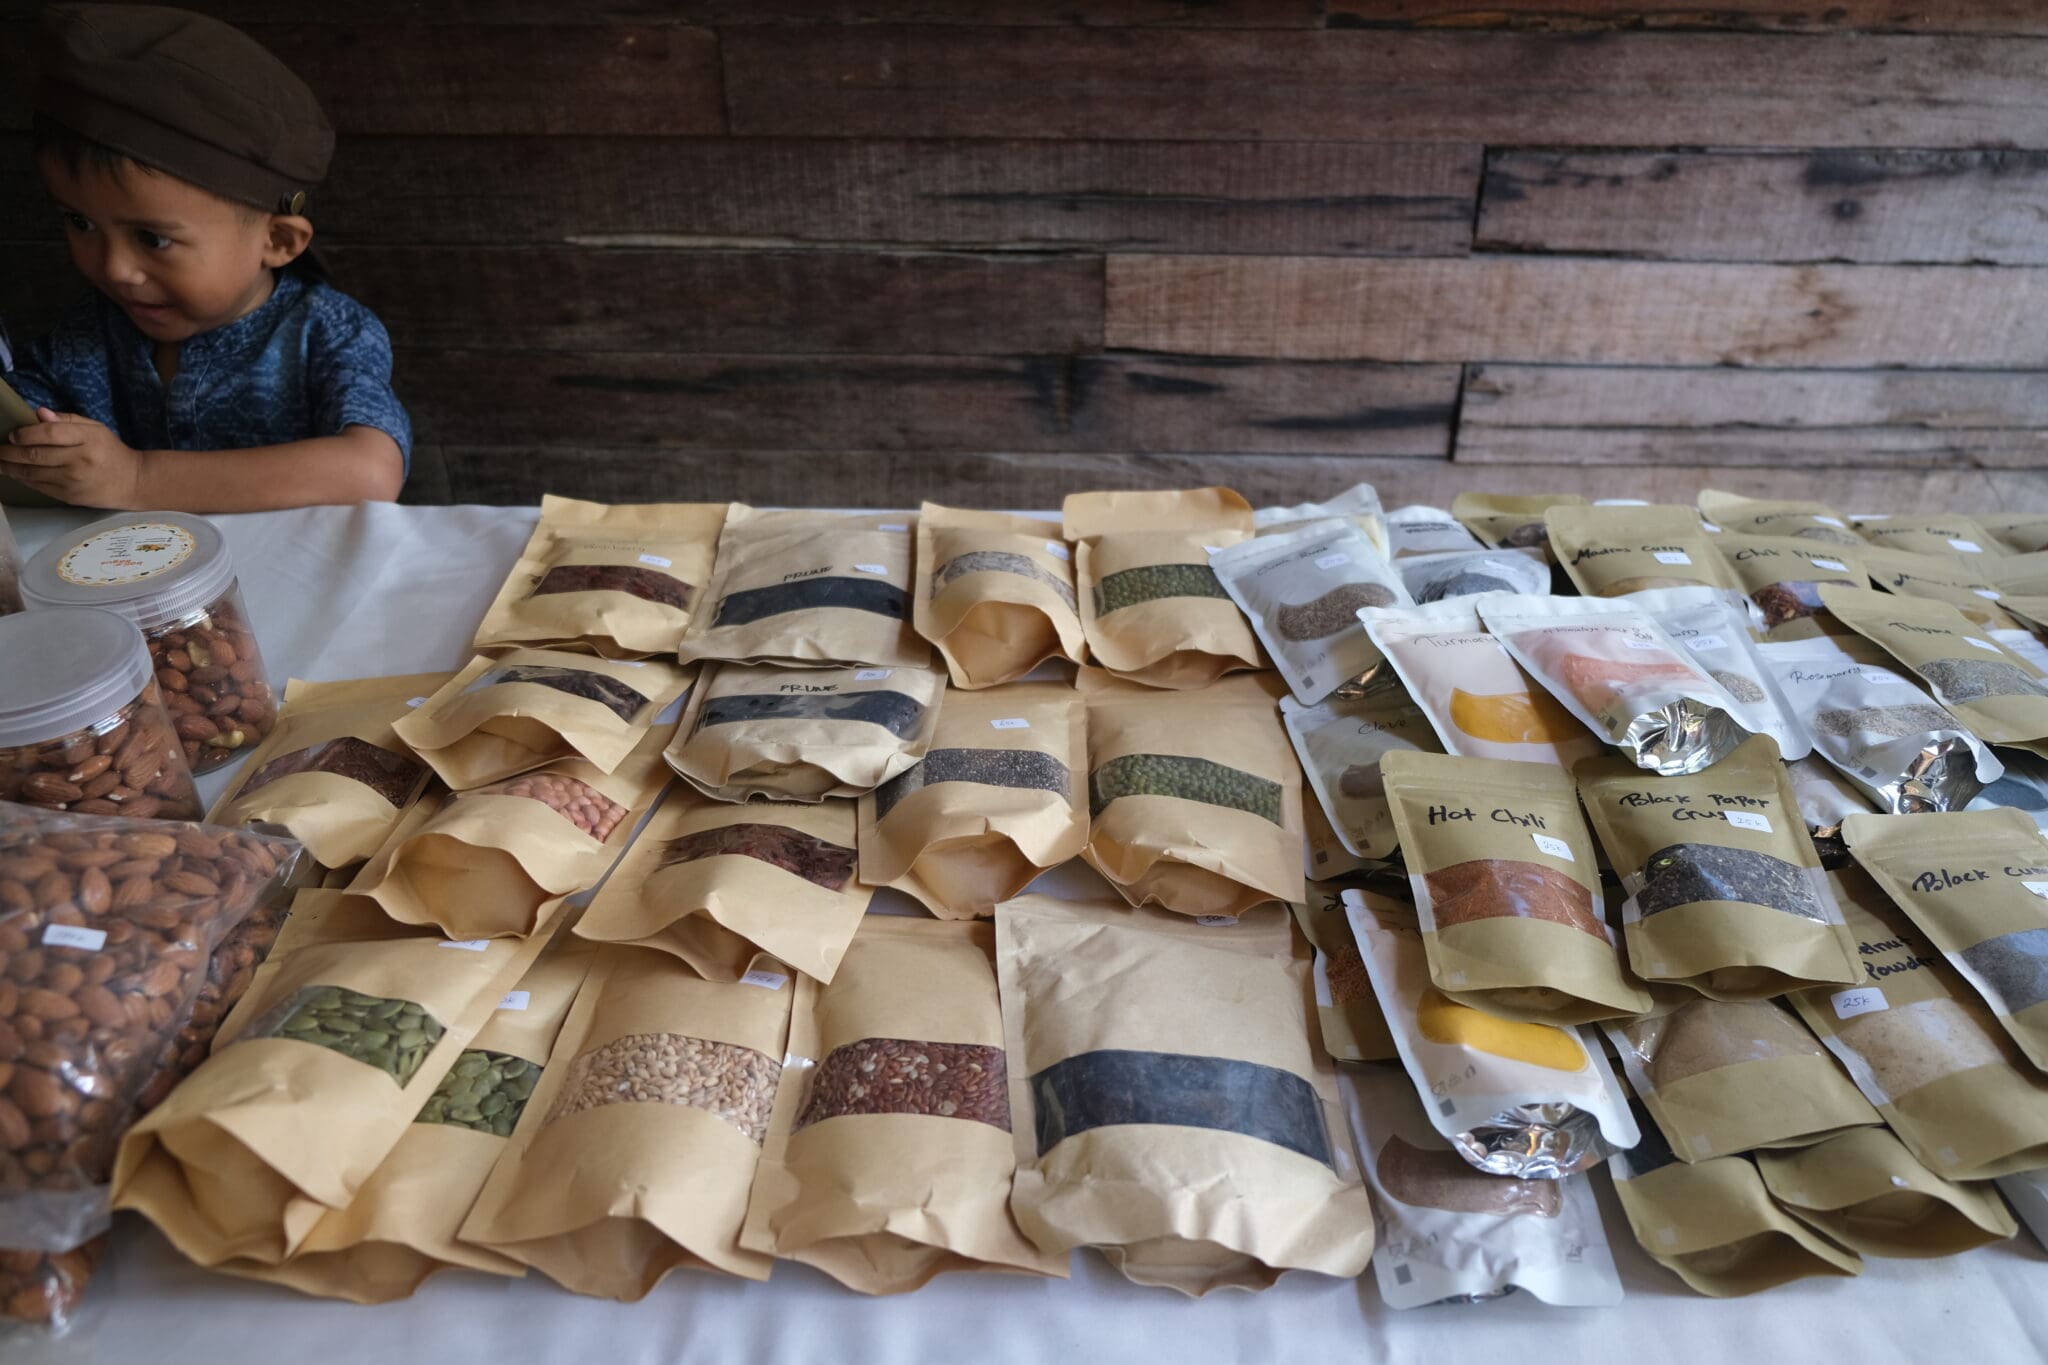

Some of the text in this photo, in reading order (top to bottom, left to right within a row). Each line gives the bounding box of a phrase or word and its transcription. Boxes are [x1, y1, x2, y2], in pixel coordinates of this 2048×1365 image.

[1619, 792, 1692, 807] Black
[1428, 805, 1546, 829] Hot Chili
[1912, 868, 1990, 893] Black
